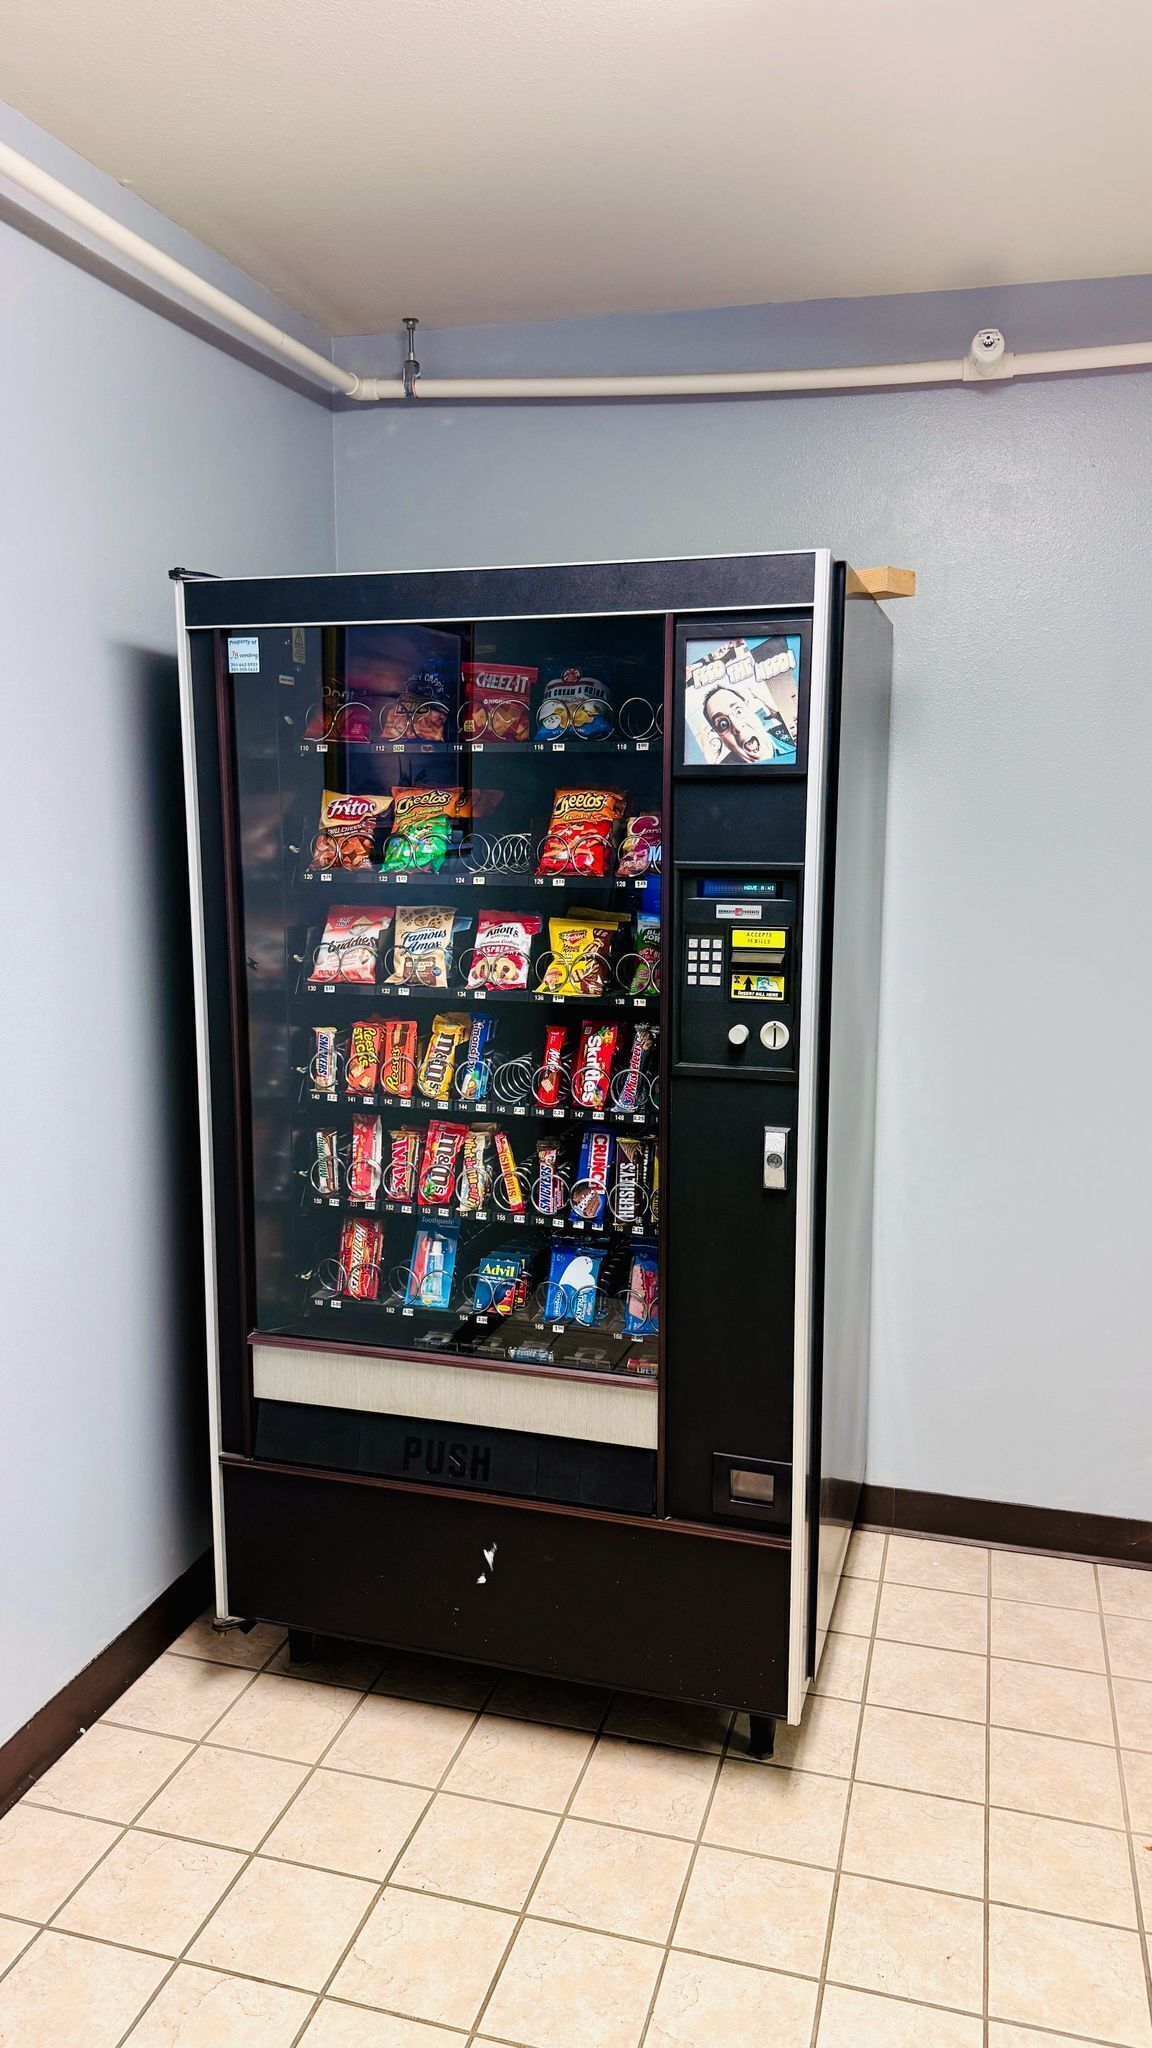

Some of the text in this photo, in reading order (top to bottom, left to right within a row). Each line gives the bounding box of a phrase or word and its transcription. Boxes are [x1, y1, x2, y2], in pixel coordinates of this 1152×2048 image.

[475, 672, 529, 694] CHEEZ-IT
[328, 798, 376, 819] Fritos
[396, 790, 452, 815] Cheetos
[552, 792, 604, 816] Cheetos
[327, 935, 375, 953] buddies
[401, 929, 447, 946] Famous
[406, 941, 442, 952] Amos
[581, 1034, 602, 1103] Skittles
[391, 1137, 410, 1189] TWIX
[590, 1134, 608, 1194] CRUNCH
[540, 1162, 553, 1212] SNICKERS
[422, 1216, 455, 1226] Toothpaste
[354, 1223, 366, 1246] HOT
[481, 1263, 515, 1277] Advil
[402, 1436, 492, 1482] PUSH
